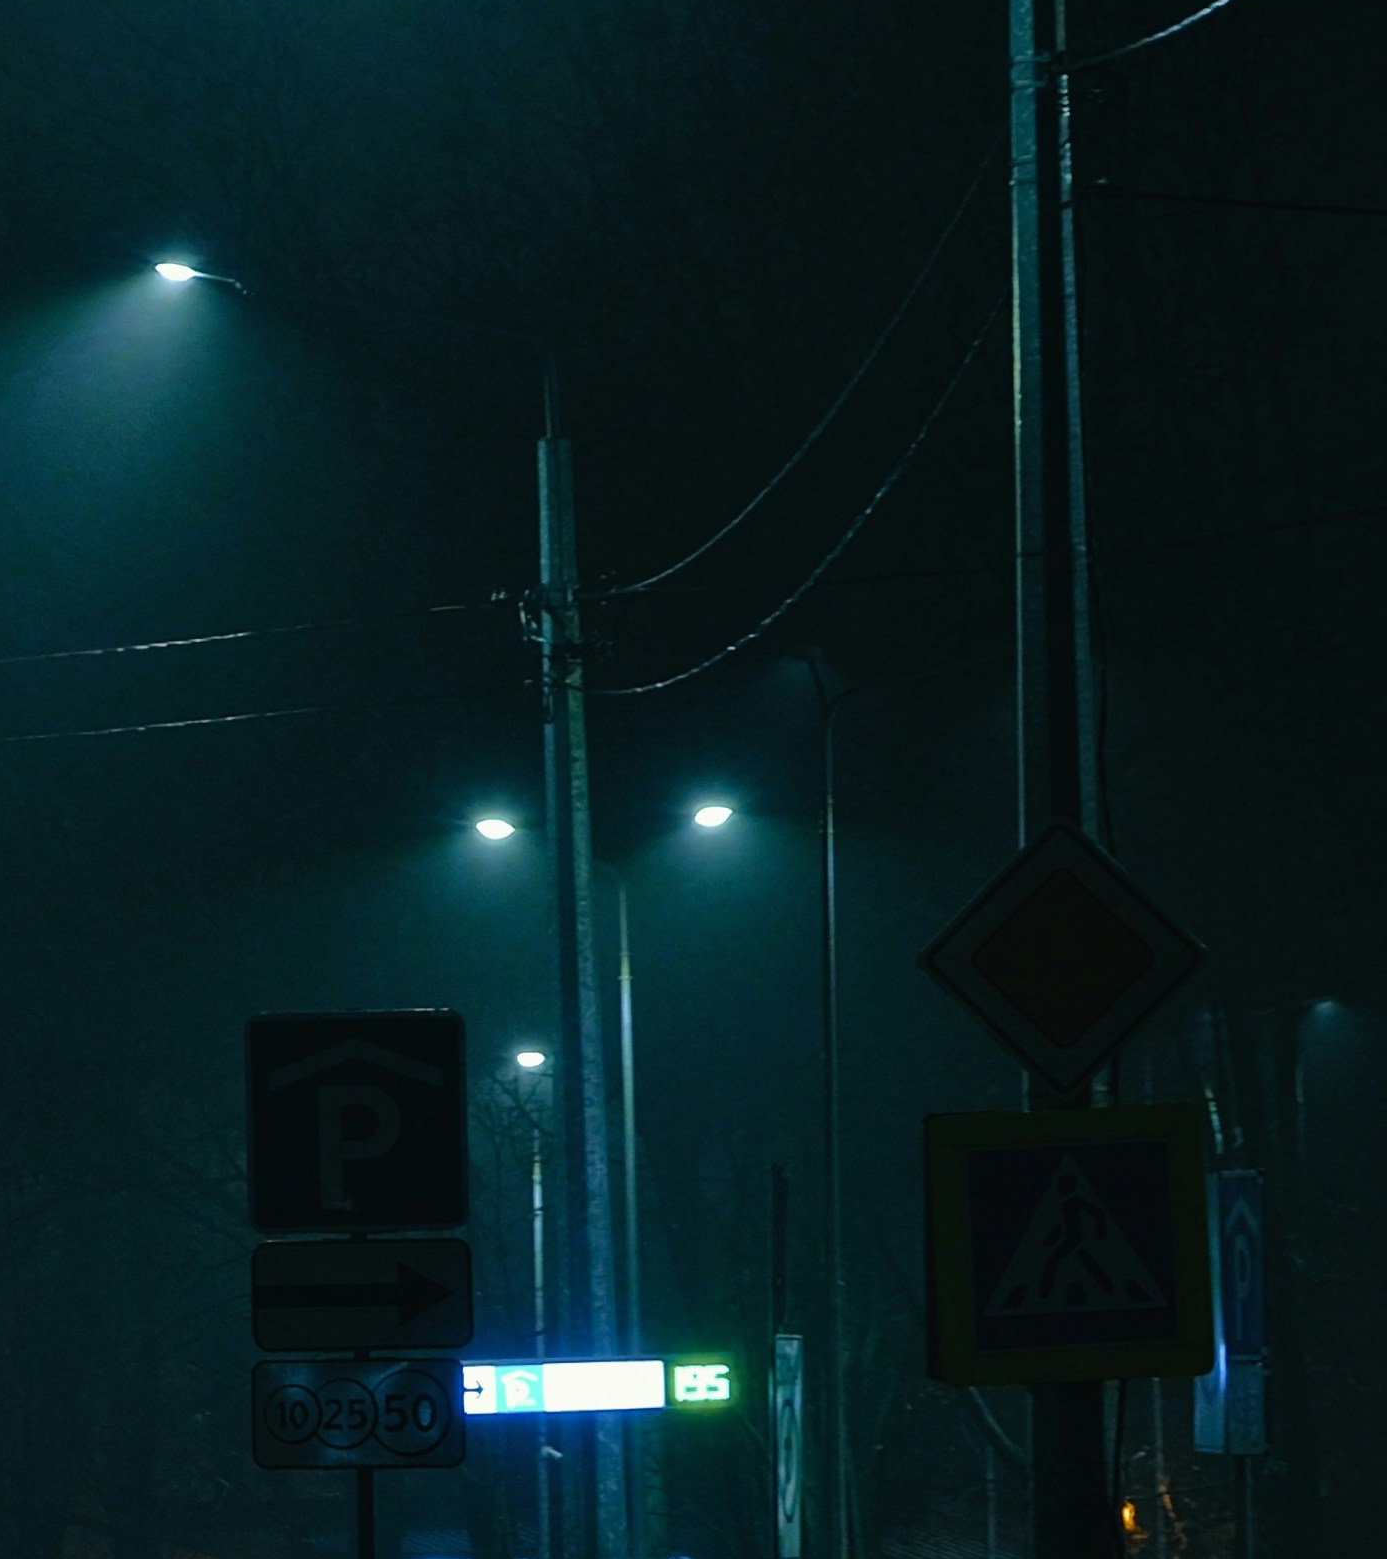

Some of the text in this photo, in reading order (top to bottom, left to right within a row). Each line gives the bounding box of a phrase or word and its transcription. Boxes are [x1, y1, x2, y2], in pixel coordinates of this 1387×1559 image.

[316, 1084, 403, 1210] P
[276, 1393, 437, 1433] 10 25 50
